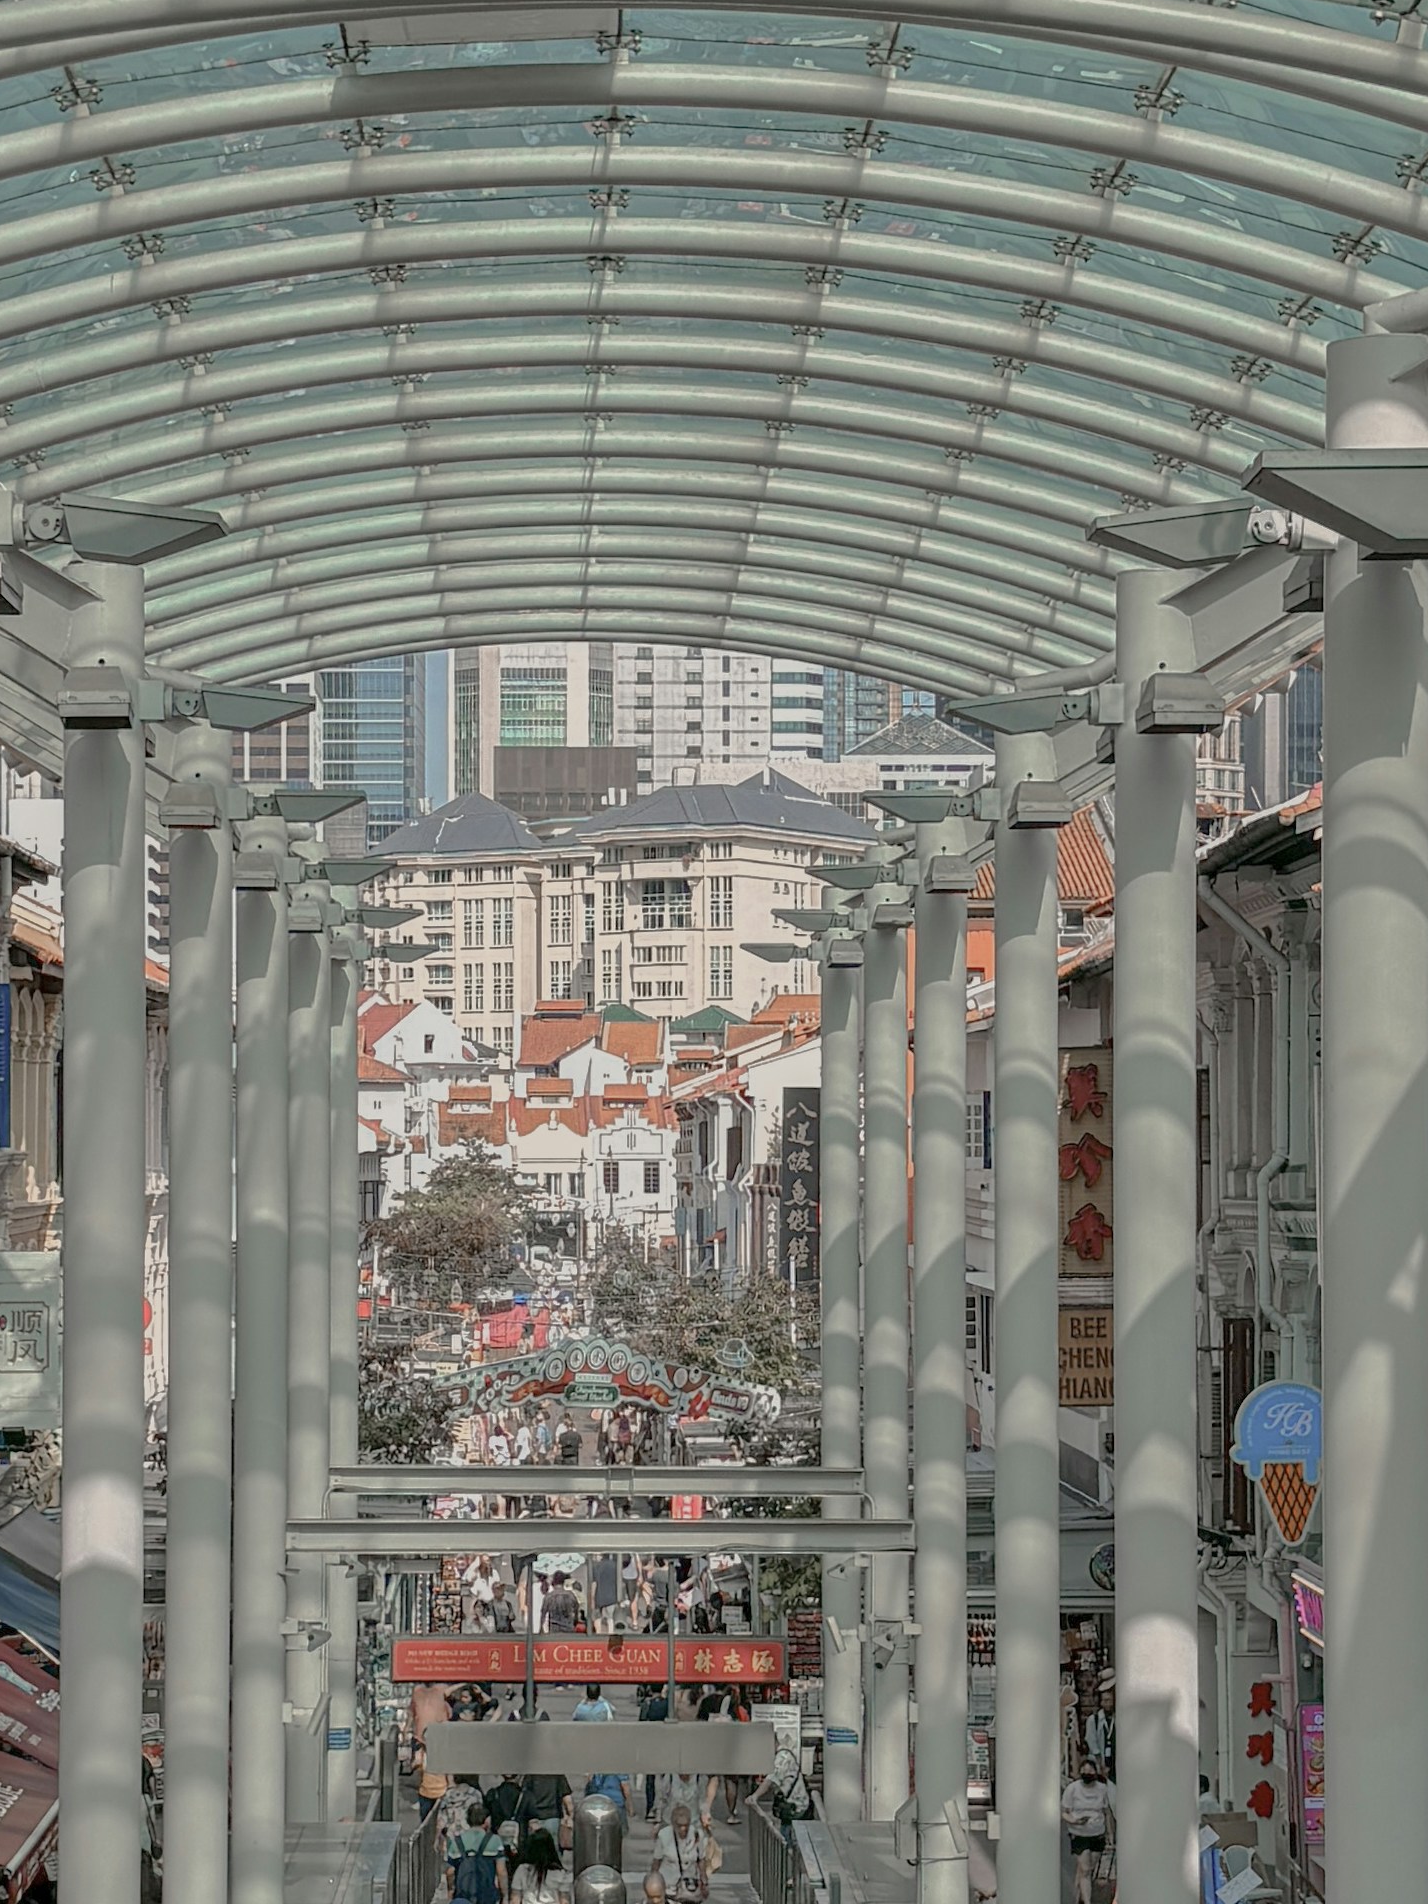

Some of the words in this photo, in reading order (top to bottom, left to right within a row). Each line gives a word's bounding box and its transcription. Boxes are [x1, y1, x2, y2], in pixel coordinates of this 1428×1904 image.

[1069, 1317, 1107, 1339] BEE
[1058, 1347, 1114, 1370] CHEN
[1058, 1376, 1114, 1399] HIAN
[513, 1645, 546, 1663] LM
[553, 1644, 603, 1663] CHEE
[609, 1648, 661, 1664] GUAN
[693, 1648, 775, 1675] 林志源
